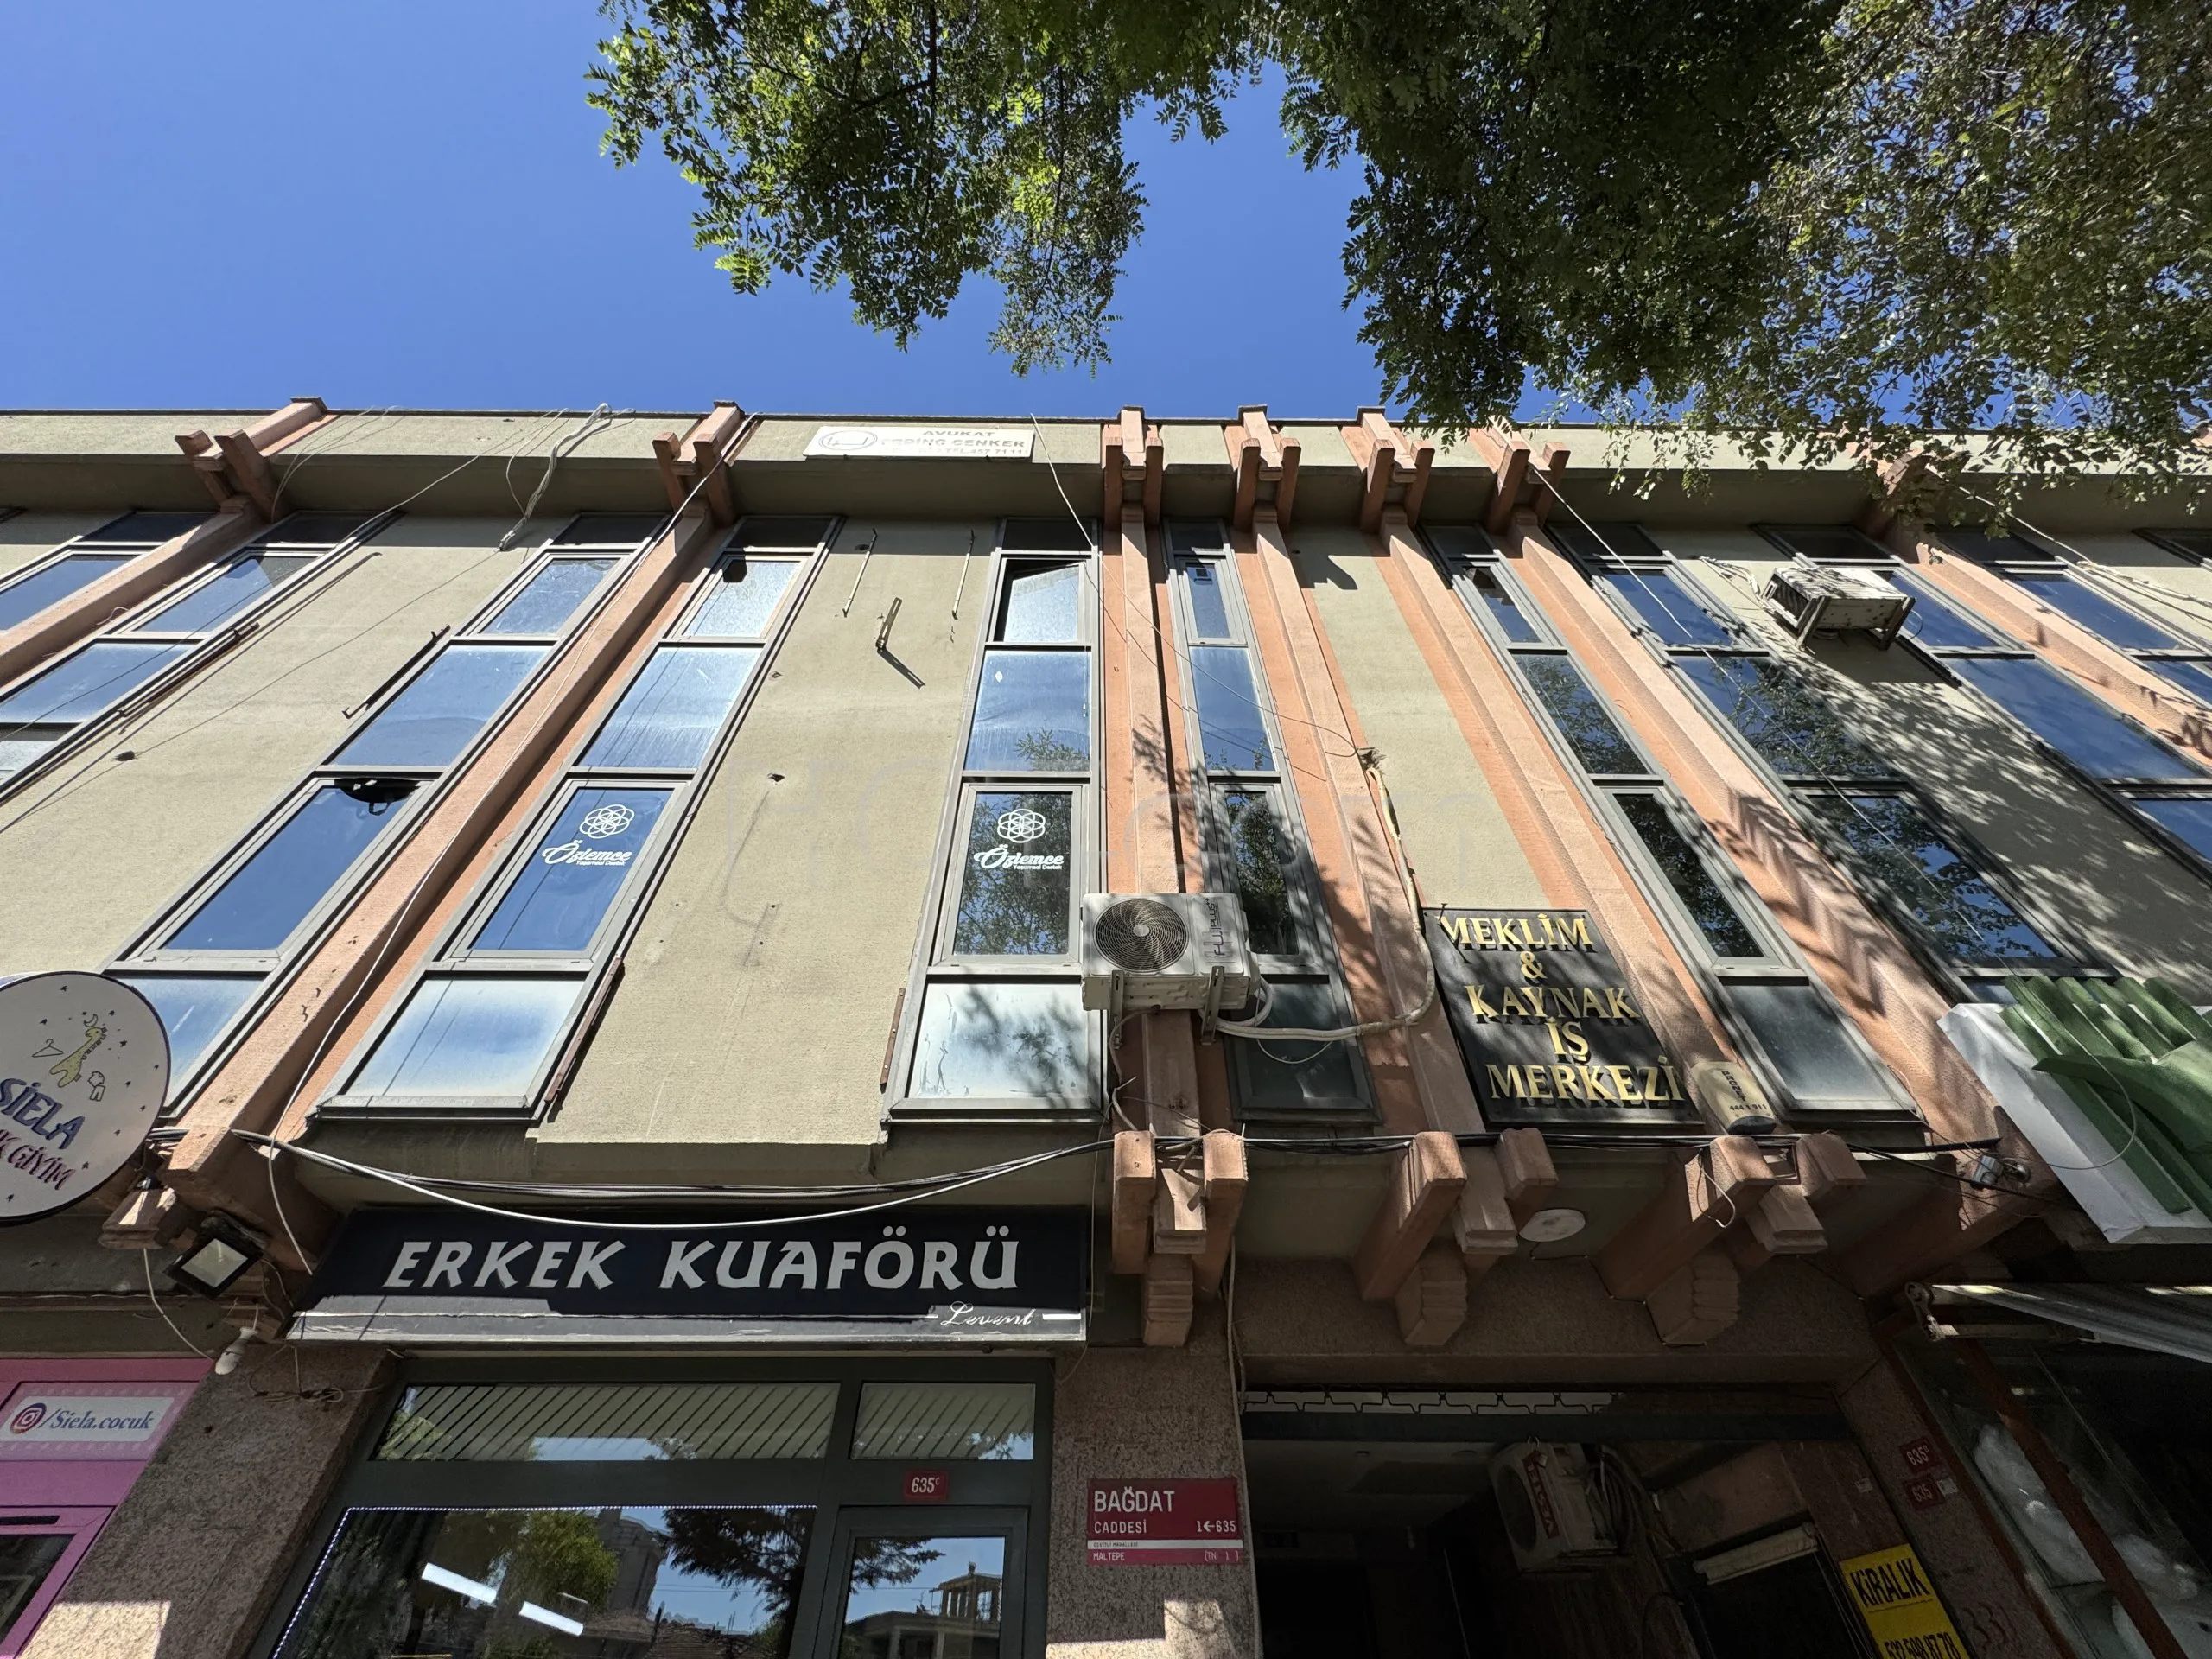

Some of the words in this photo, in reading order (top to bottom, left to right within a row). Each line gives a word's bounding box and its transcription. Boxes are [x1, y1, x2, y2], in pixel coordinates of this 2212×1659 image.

[921, 429, 996, 438] AVUKAT
[542, 840, 632, 865] Özlemce
[974, 844, 1065, 869] Özlemce
[1519, 950, 1548, 980] &
[1465, 983, 1641, 1020] KAYNAK
[1547, 1016, 1590, 1066] İŞ
[1484, 1055, 1686, 1102] MERKEZİ
[7, 1144, 77, 1191] GİYİM
[382, 1240, 626, 1290] ERKEK
[658, 1225, 1019, 1292] KUAFÖRÜ
[940, 1300, 1036, 1327] Levent
[1094, 1485, 1176, 1513] BAĞDAT
[1911, 1484, 1933, 1503] 635
[1094, 1519, 1147, 1535] CADDESİ
[1092, 1551, 1125, 1561] MALTEPE
